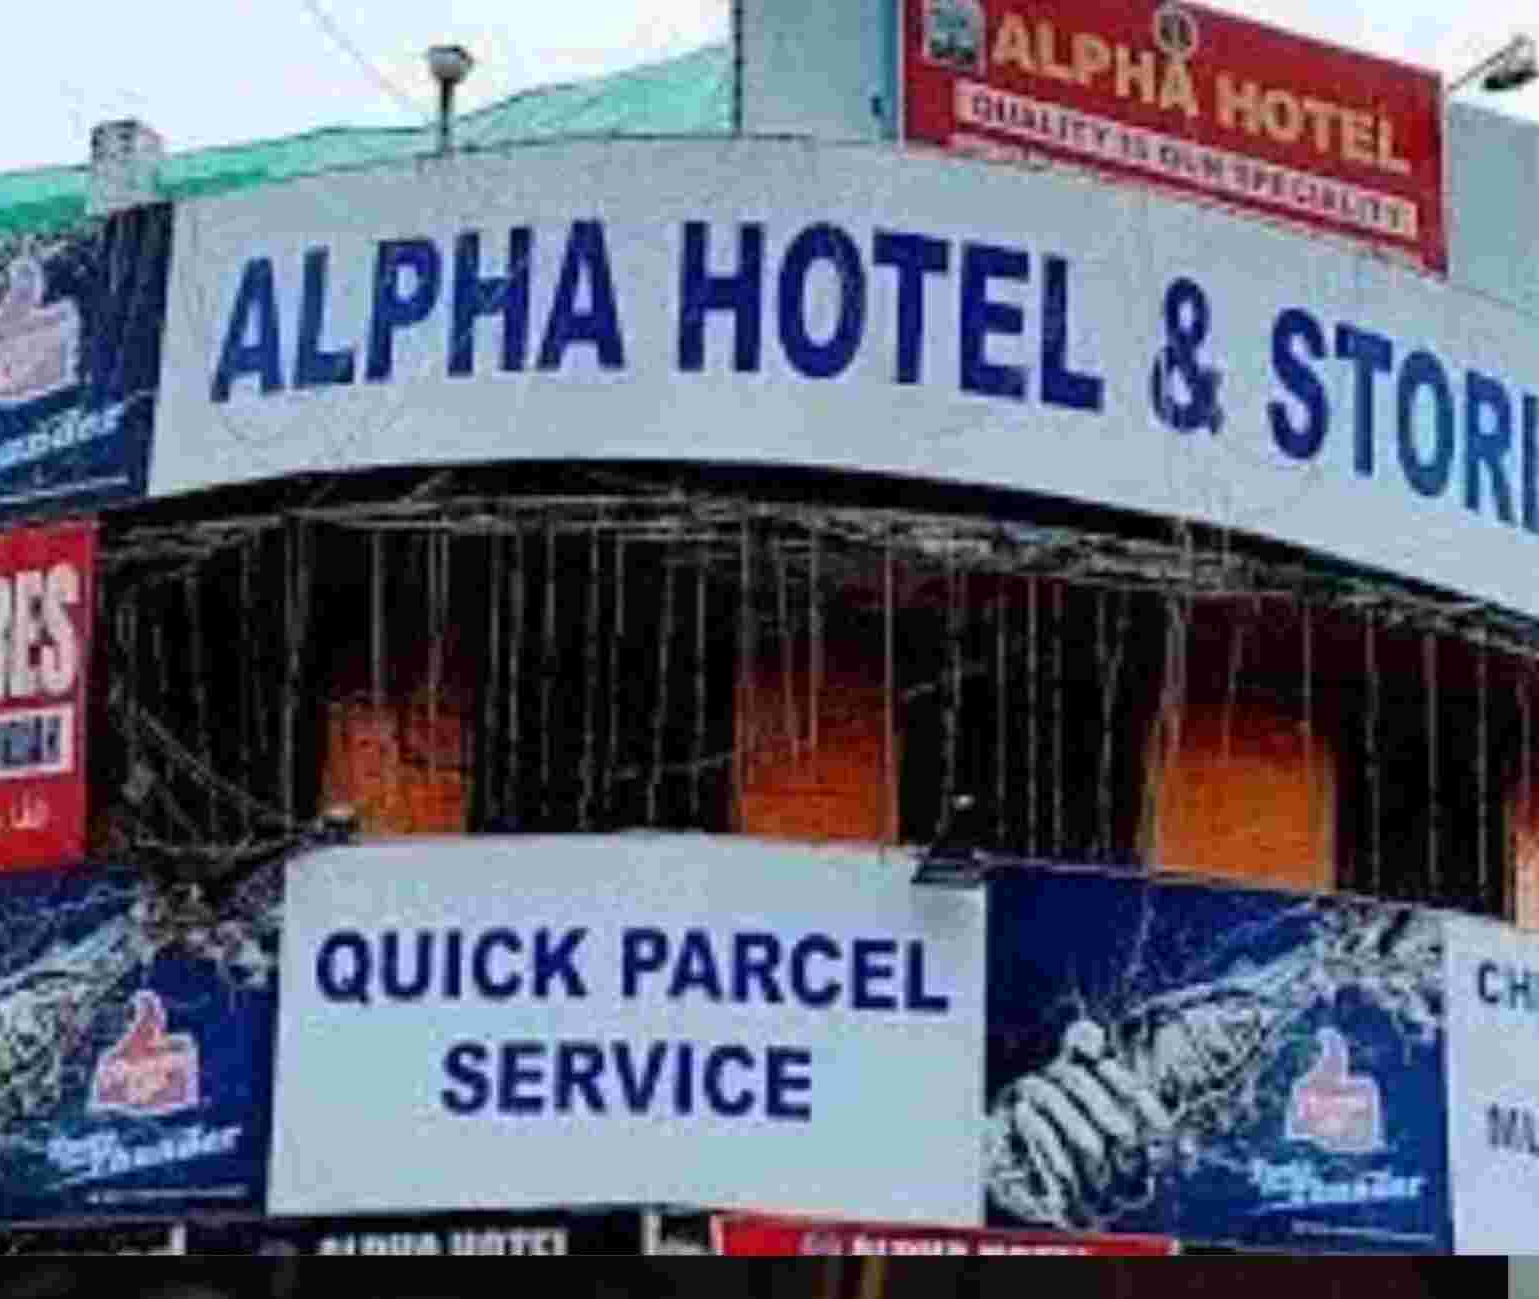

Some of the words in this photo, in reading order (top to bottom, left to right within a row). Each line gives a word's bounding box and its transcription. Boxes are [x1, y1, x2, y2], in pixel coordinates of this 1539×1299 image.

[971, 91, 1112, 152] QUALITY
[993, 12, 1199, 117] ALPHA
[1215, 72, 1411, 173] HOTEL
[209, 219, 626, 403] ALPHA
[676, 220, 1106, 414] HOTEL
[1150, 276, 1224, 436] &
[314, 926, 588, 1006] QUICK
[621, 927, 951, 1014] PARCEL
[440, 1039, 814, 1123] SERVICE
